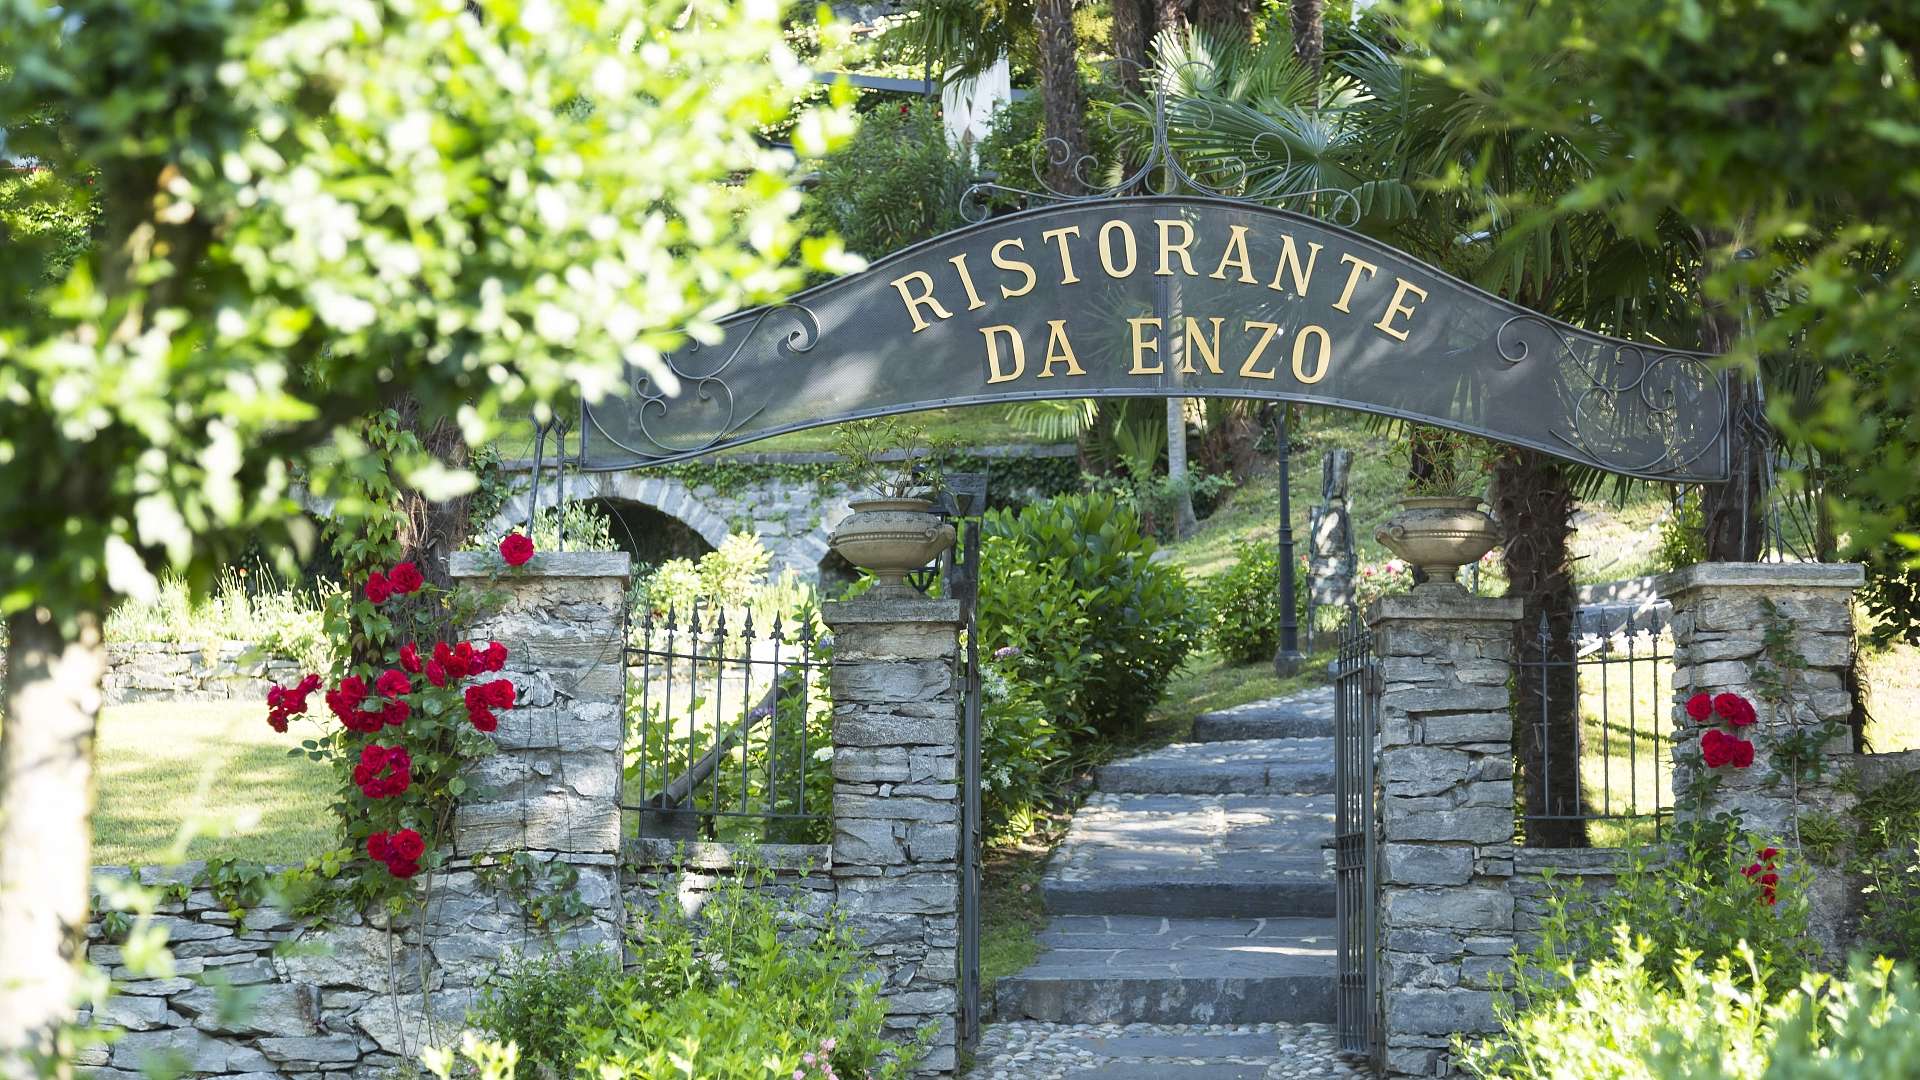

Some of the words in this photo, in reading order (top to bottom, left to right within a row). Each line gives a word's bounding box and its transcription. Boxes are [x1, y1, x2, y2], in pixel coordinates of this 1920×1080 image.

[890, 219, 1428, 341] RISTORANTE
[979, 320, 1087, 384] DA
[1127, 317, 1331, 384] ENZO
